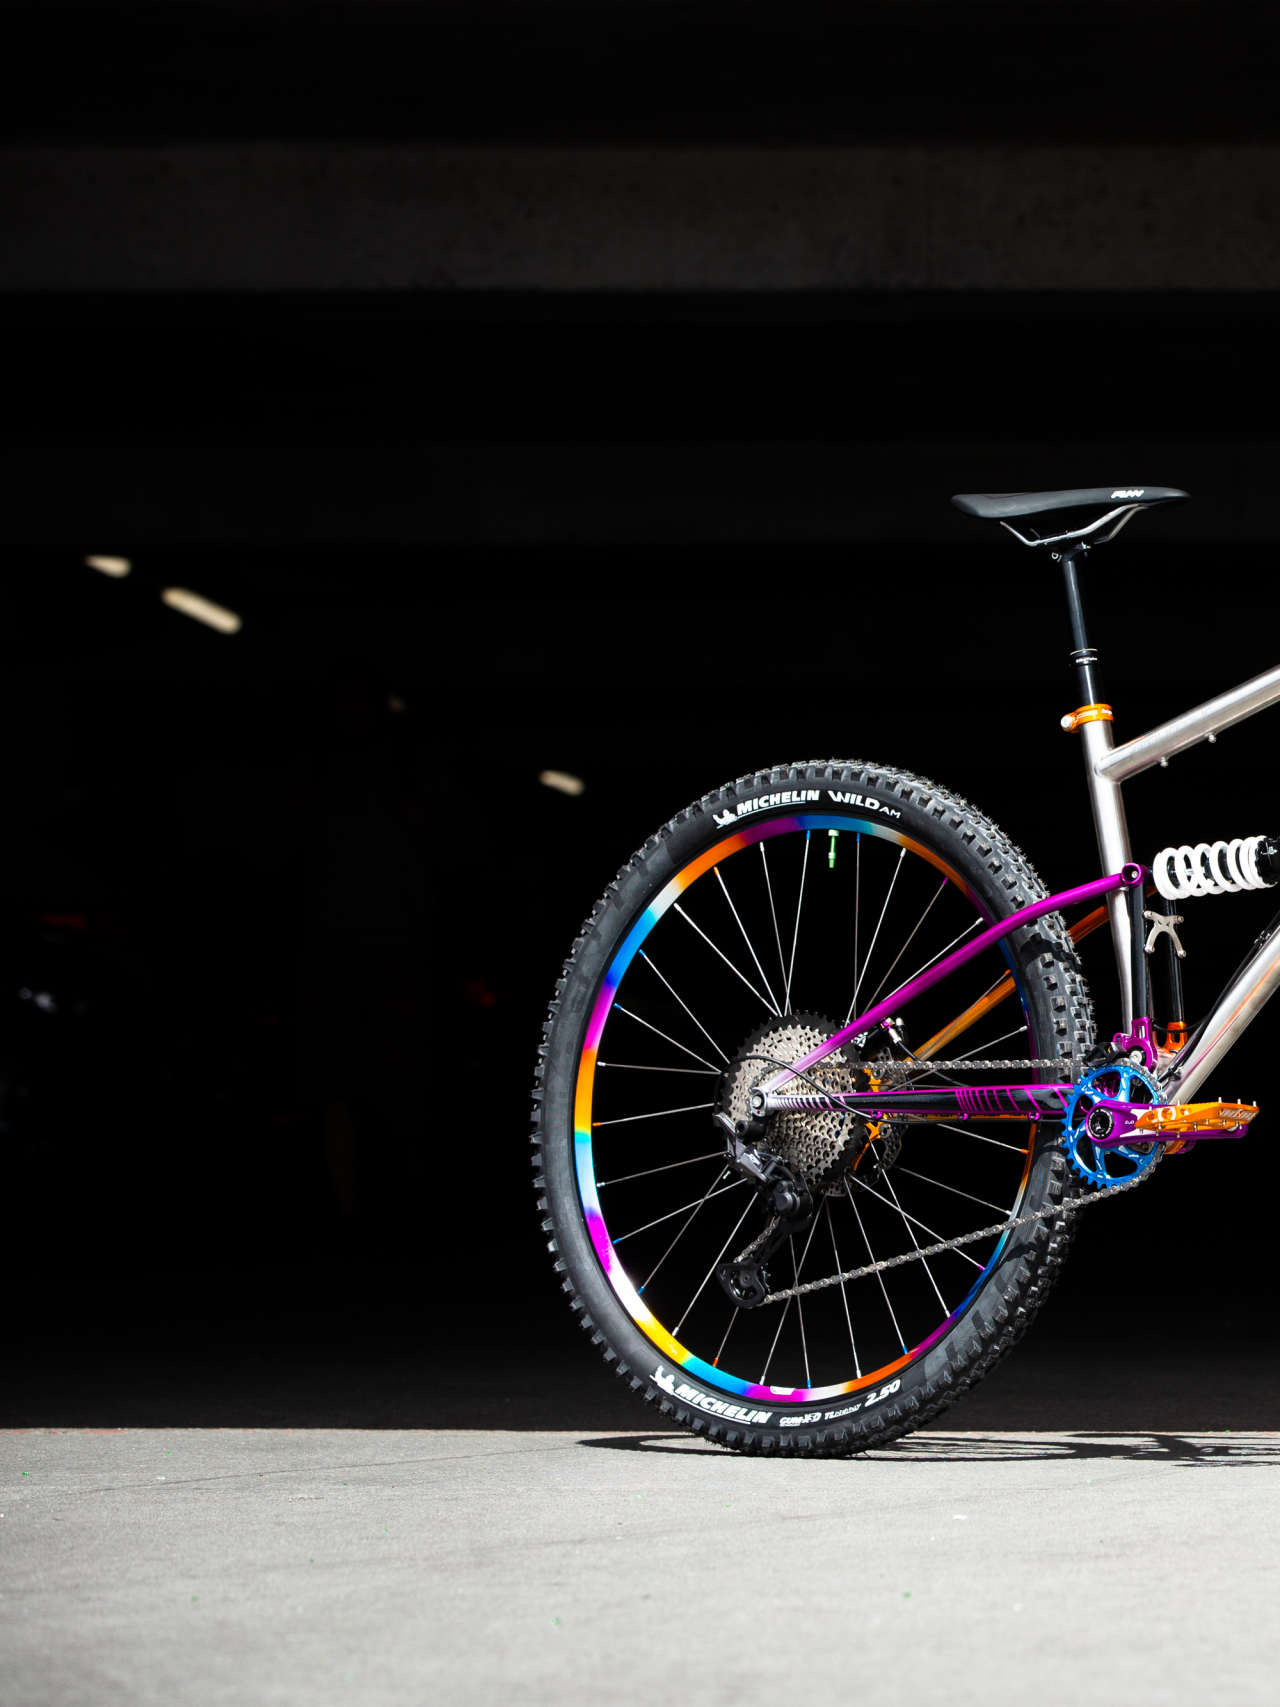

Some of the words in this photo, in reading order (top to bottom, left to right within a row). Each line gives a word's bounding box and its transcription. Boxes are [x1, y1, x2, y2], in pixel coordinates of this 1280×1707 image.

[736, 789, 820, 816] MICHELIN
[828, 790, 880, 811] WILD
[879, 805, 902, 819] AM
[674, 1384, 773, 1424] MICHELIN
[864, 1379, 901, 1407] 2.50
